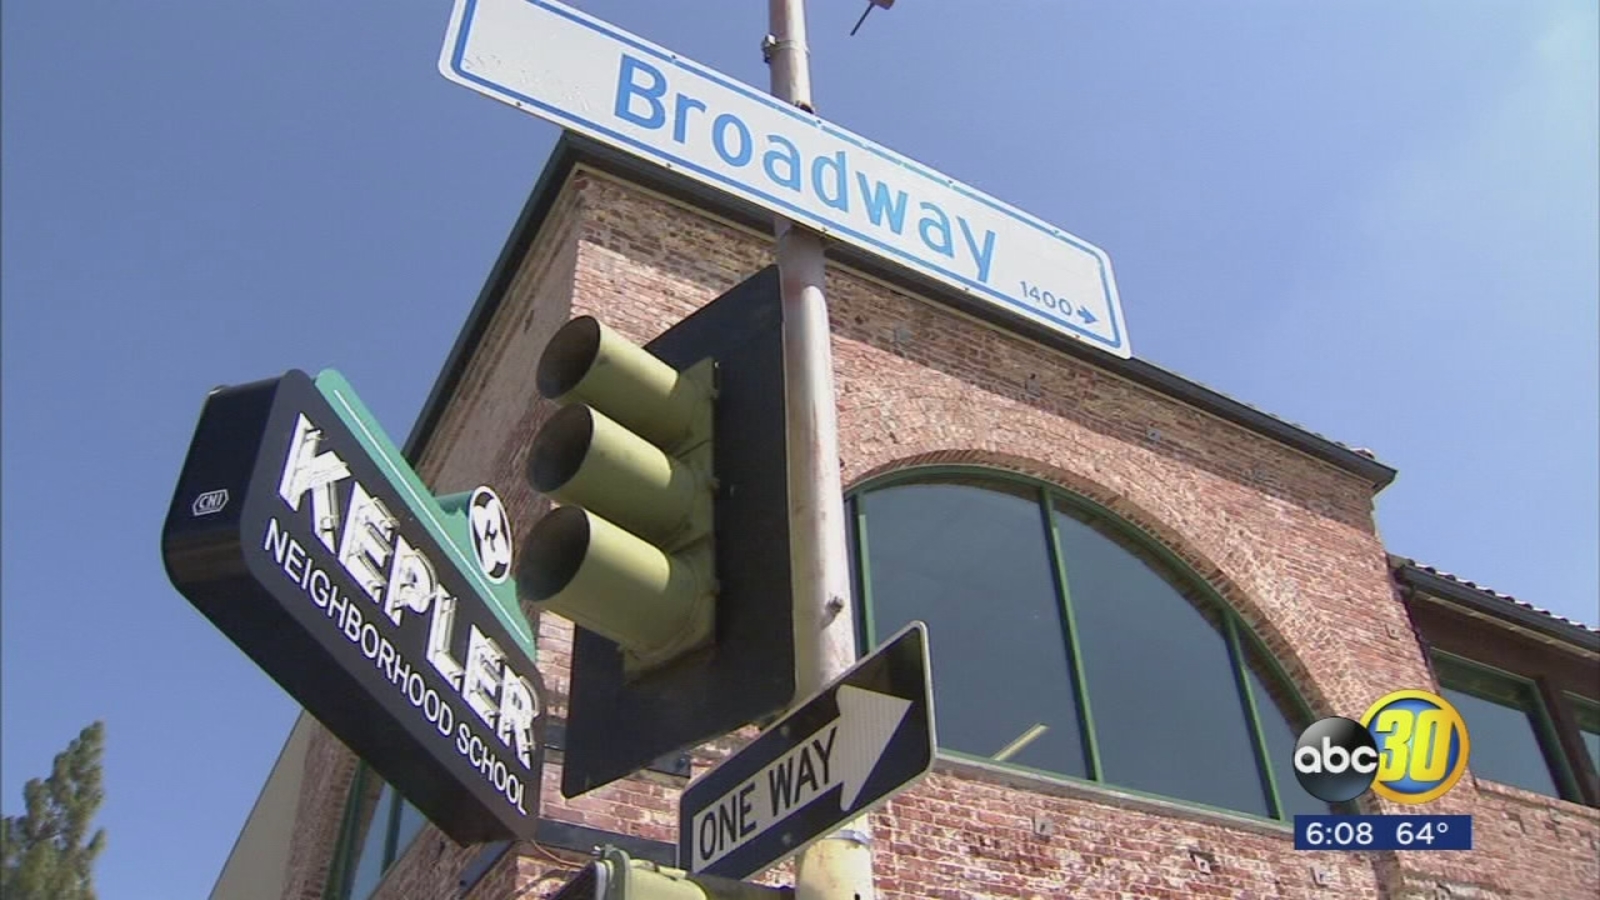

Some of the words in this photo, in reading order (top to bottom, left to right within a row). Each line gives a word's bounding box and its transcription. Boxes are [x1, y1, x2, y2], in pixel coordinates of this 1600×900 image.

[613, 53, 995, 282] Broadway
[1020, 281, 1072, 316] 1400
[263, 517, 453, 737] NEIGHBORHOOD
[456, 724, 527, 815] SCHOOL
[279, 412, 538, 769] KEPLER
[700, 783, 756, 860] ONE
[769, 726, 837, 816] WAY
